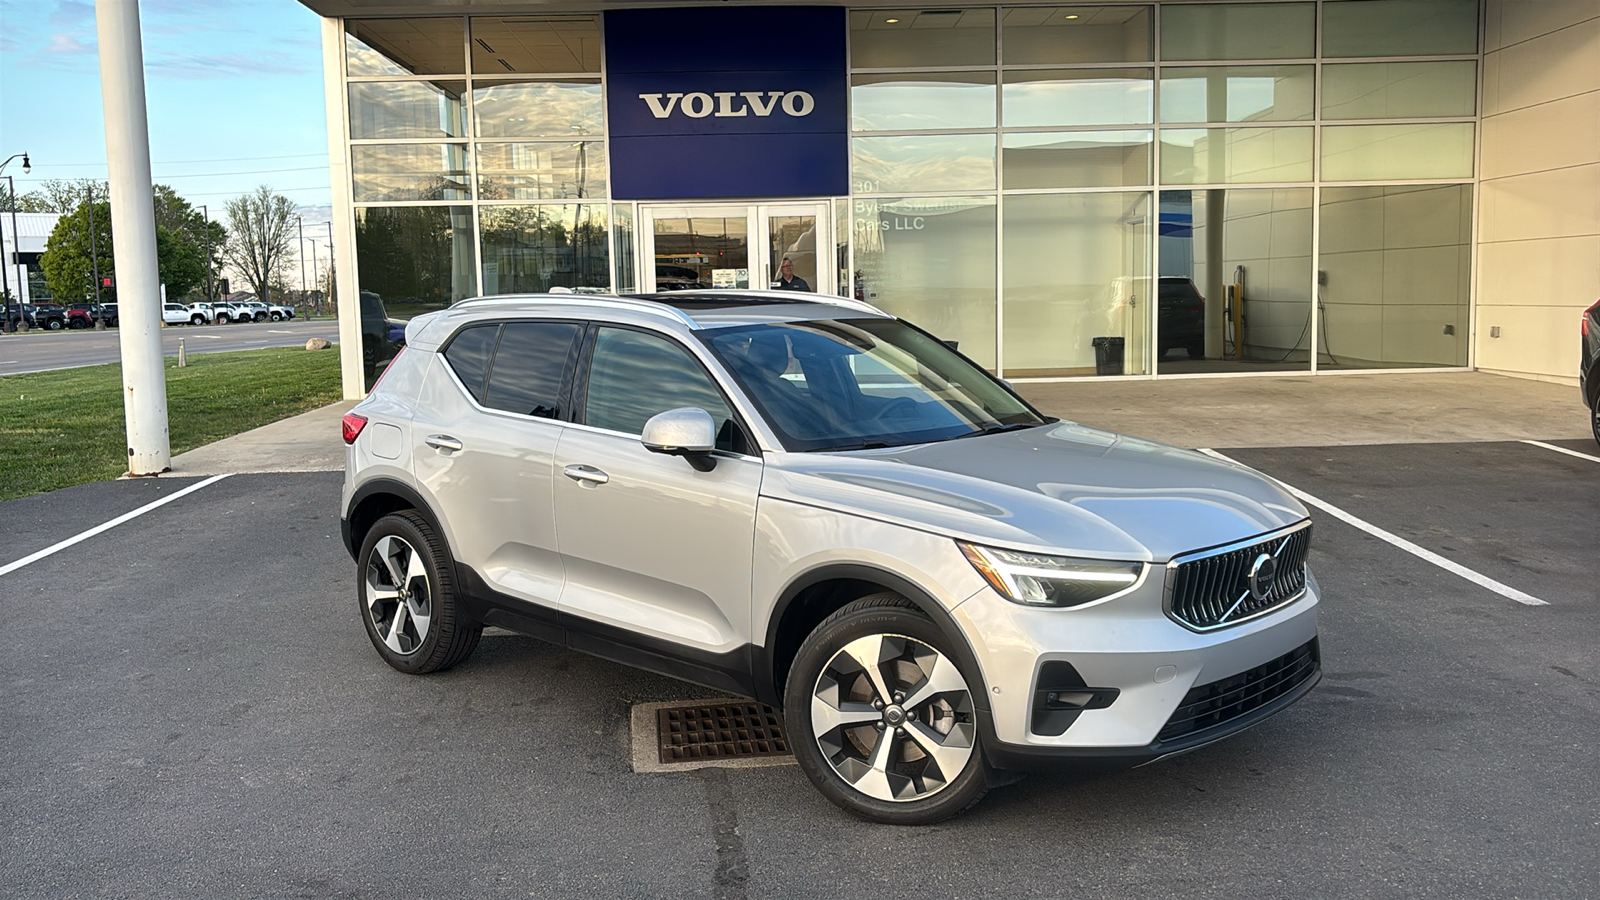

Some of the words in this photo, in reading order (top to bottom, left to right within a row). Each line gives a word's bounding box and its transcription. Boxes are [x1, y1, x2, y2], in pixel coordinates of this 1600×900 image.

[639, 90, 815, 119] VOLVO
[855, 180, 880, 193] 301
[855, 201, 897, 216] Byers
[855, 218, 890, 231] Cars
[895, 217, 925, 230] LLC
